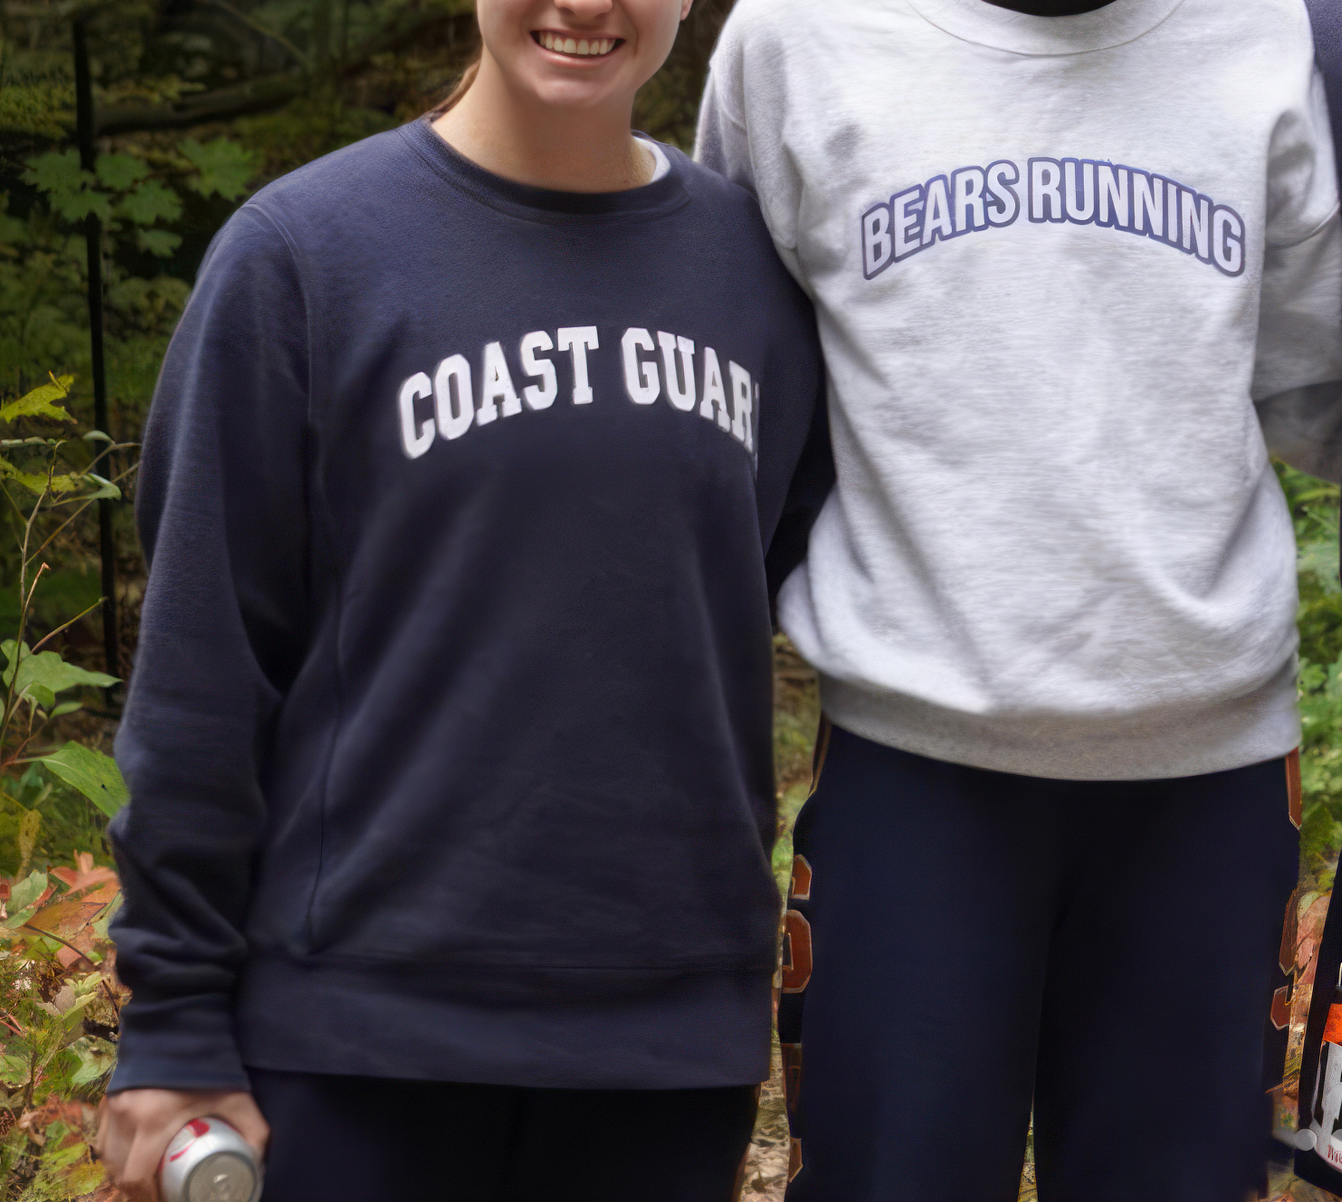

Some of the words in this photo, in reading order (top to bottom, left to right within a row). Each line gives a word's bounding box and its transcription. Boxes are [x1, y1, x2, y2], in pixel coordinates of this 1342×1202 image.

[862, 160, 1020, 280] BEARS
[1027, 157, 1245, 276] RUNNING
[399, 326, 600, 459] COAST
[620, 326, 759, 470] GUAR
